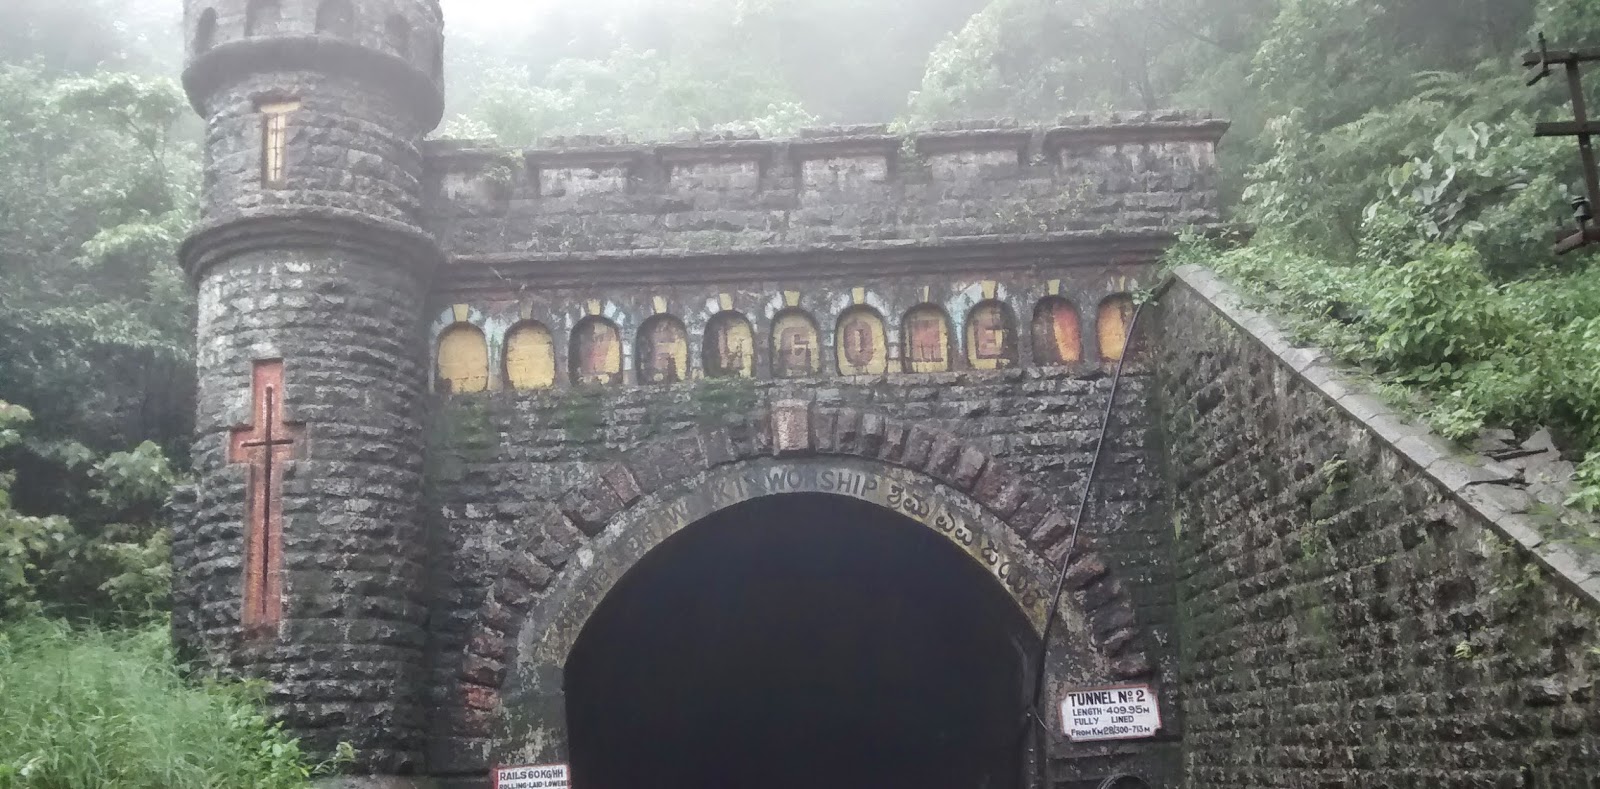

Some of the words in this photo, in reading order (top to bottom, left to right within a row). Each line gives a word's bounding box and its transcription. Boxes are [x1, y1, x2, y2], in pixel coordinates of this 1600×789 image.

[1068, 691, 1116, 707] TUNNEL
[1136, 689, 1146, 703] 2
[1074, 717, 1100, 726] FULLY
[1111, 715, 1135, 724] LINED
[499, 771, 527, 781] RAILS
